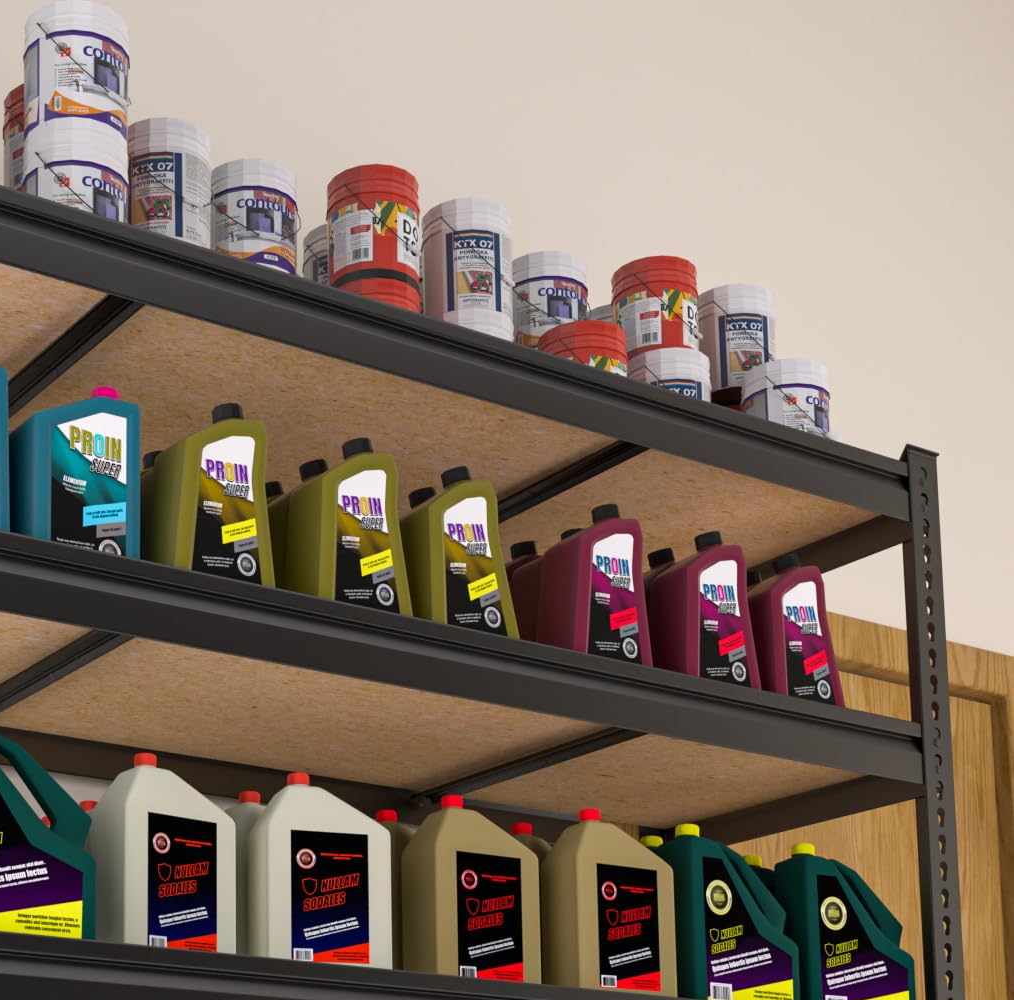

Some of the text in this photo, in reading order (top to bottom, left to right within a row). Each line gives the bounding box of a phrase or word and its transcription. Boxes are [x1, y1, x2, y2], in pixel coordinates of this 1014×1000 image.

[156, 162, 174, 171] 07
[480, 240, 494, 248] 07
[750, 321, 763, 330] 07
[684, 388, 697, 397] 07
[69, 425, 122, 463] PROIN
[90, 458, 122, 480] SUPER
[206, 459, 249, 484] PROIN
[224, 483, 250, 498] SUPER
[341, 494, 383, 517] PROIN
[359, 516, 384, 531] SUPER
[447, 522, 485, 543] PROIN
[595, 555, 631, 577] PROIN
[703, 583, 736, 602] PROIN
[786, 605, 817, 624] PROIN
[174, 862, 209, 879] NULLAM
[158, 880, 197, 898] SODALES
[321, 873, 360, 893] NULLAM
[303, 891, 346, 912] SODALES
